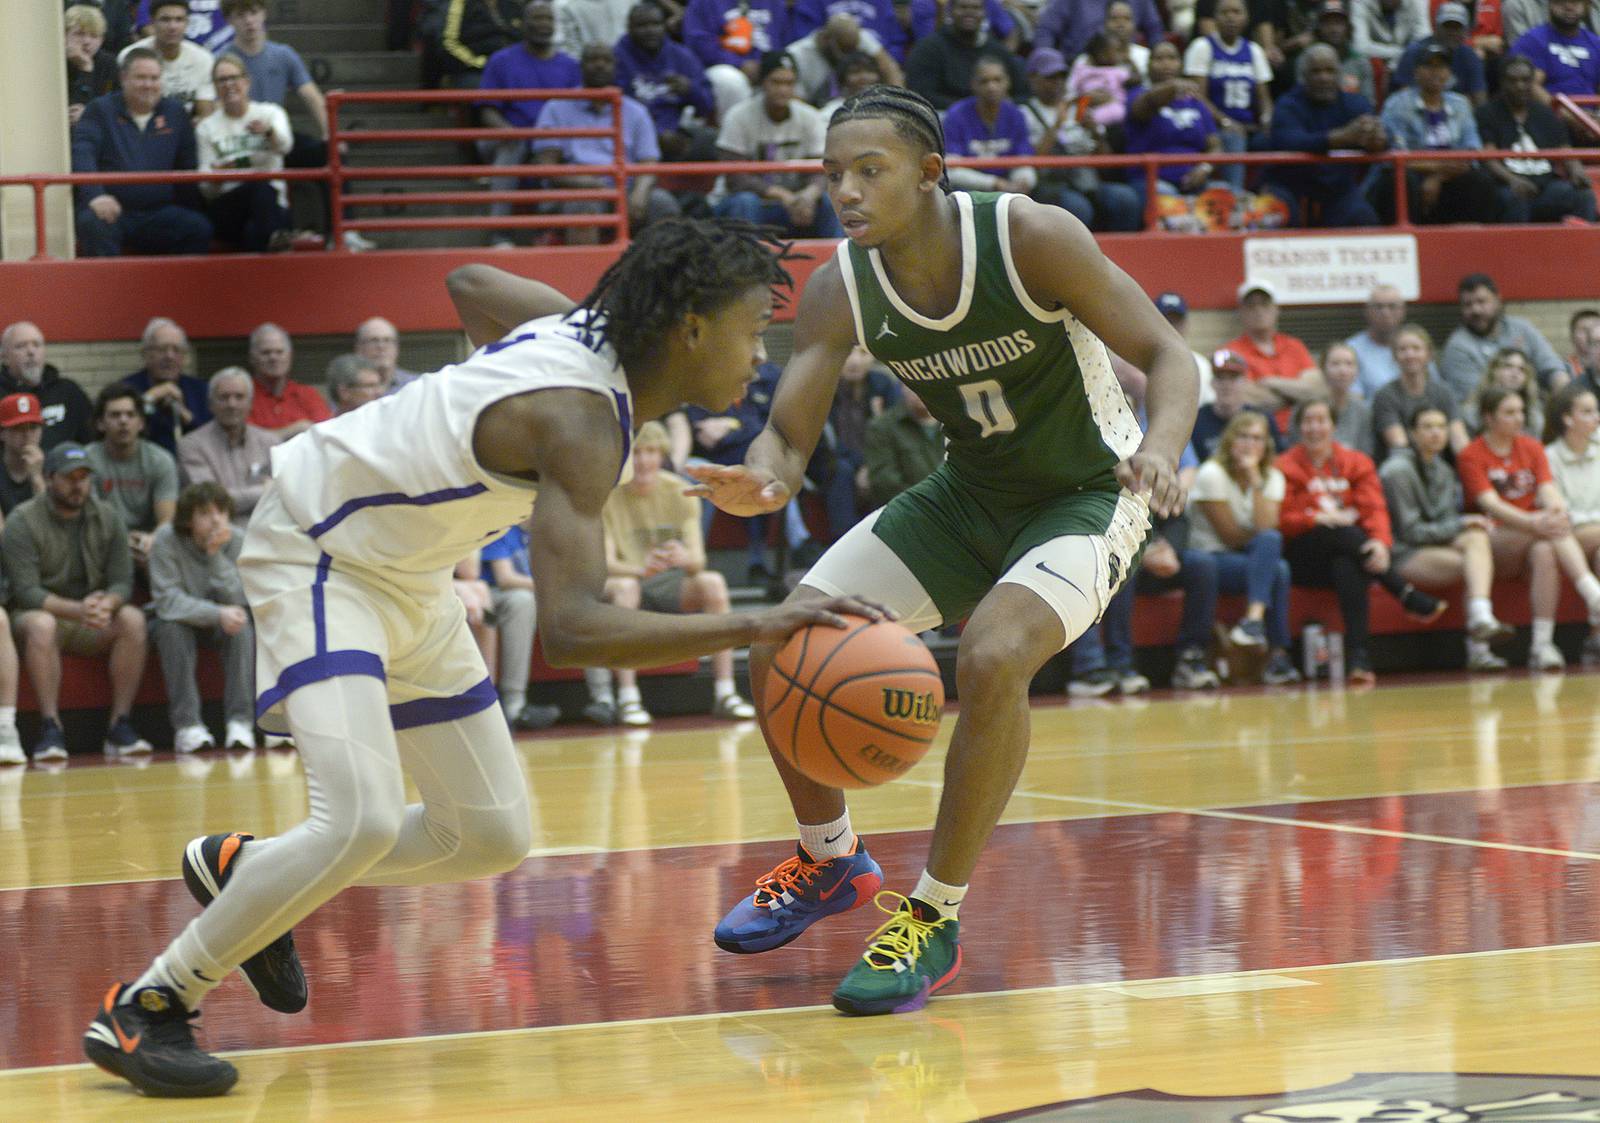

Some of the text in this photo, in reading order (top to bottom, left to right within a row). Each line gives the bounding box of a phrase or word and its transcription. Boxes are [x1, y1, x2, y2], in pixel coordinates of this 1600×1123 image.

[1338, 246, 1409, 266] TICKET
[889, 328, 1037, 382] RICHWOODS
[957, 378, 1018, 439] 0
